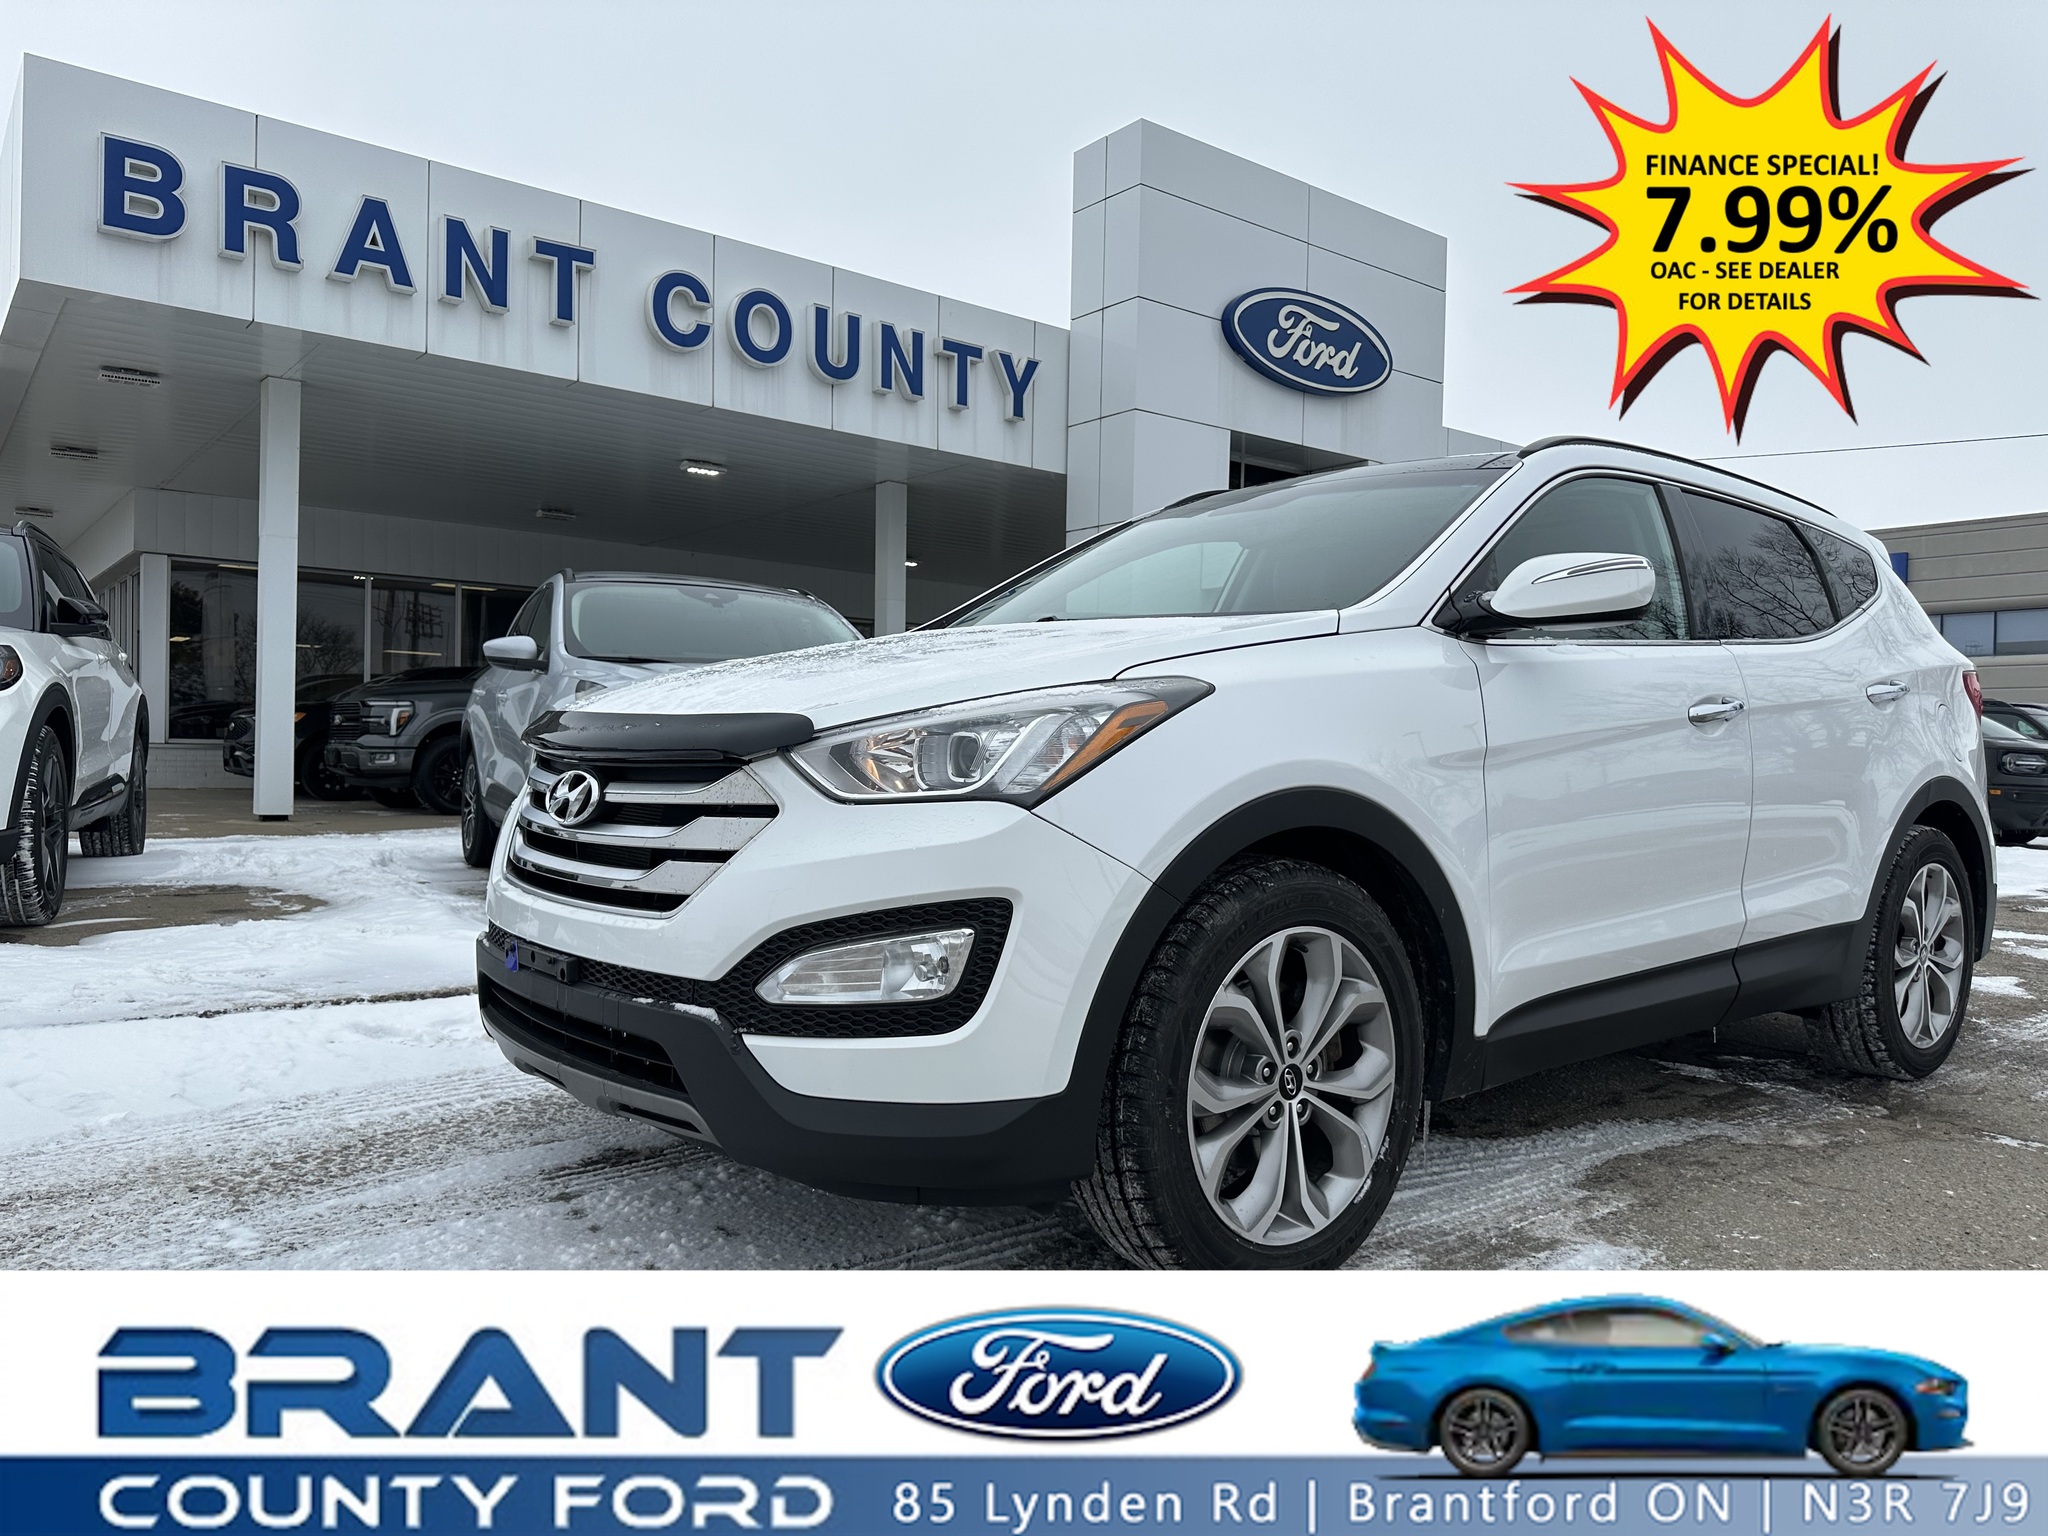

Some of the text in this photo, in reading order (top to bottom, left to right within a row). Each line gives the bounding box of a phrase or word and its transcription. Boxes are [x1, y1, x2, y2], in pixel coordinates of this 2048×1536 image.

[97, 132, 1041, 423] BRANT COUNTY
[1267, 304, 1362, 380] Ford
